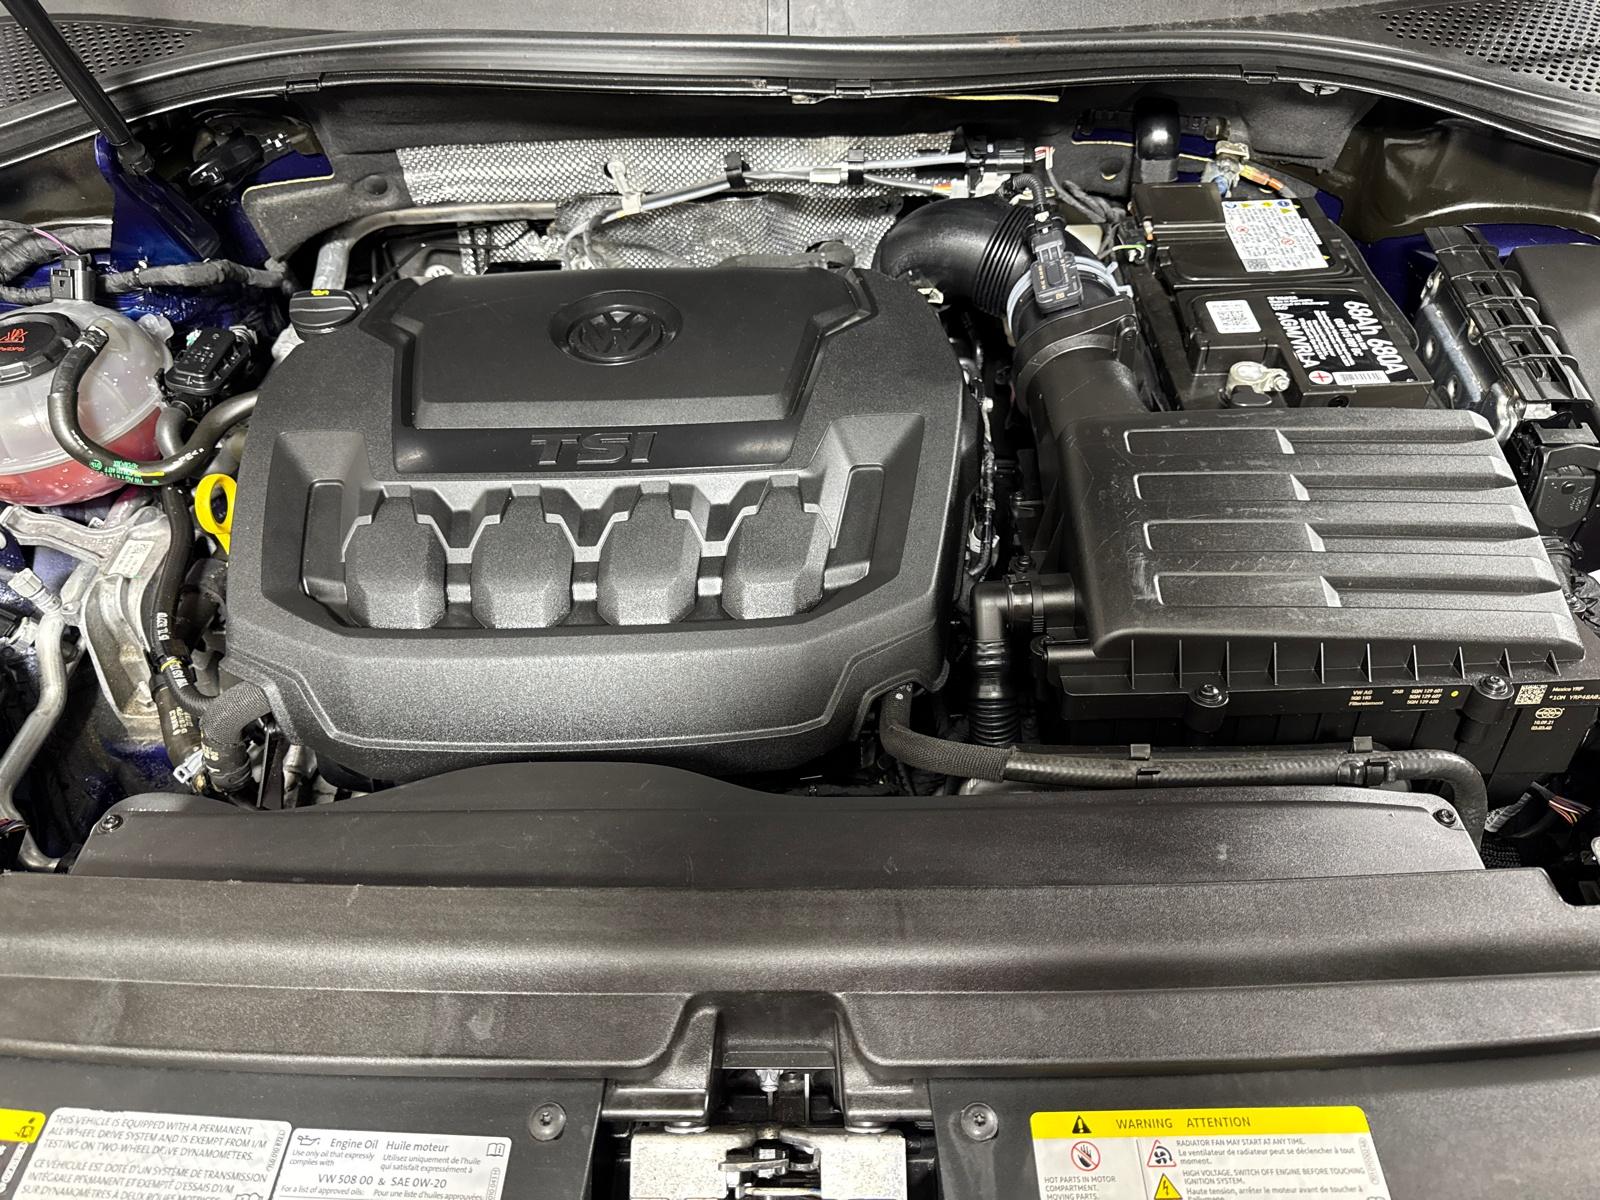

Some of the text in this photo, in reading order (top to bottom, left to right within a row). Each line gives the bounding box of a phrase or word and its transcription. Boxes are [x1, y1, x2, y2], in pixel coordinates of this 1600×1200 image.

[1274, 311, 1321, 368] AGM/VRLA
[1343, 301, 1409, 374] 68Ah 680A
[530, 431, 658, 465] TSI
[55, 1114, 75, 1124] THIS
[75, 1116, 110, 1126] VEHICLE
[121, 1120, 165, 1131] EQUIPPED
[166, 1122, 190, 1131] WITH
[198, 1123, 253, 1135] PERMANENT
[1116, 1116, 1251, 1129] WARNING ATTENTION
[48, 1127, 96, 1137] ALL-WHEEL
[97, 1130, 124, 1139] DRIVE
[158, 1133, 178, 1143] AND
[182, 1135, 188, 1143] IS
[189, 1136, 224, 1146] EXEMPT
[224, 1138, 250, 1147] FROM
[1272, 1137, 1286, 1145] ANY
[44, 1139, 254, 1160] TESTING ON TWO-WHEEL DRIVE DYNAMOMETERS.
[330, 1138, 379, 1150] Engine Oil
[386, 1141, 449, 1152] Huile moteur
[344, 1152, 375, 1160] expressly
[1188, 1148, 1226, 1156] ventilateur
[1227, 1148, 1236, 1156] de
[1237, 1147, 1268, 1155] radiateur
[1270, 1148, 1286, 1156] peut
[289, 1159, 318, 1167] complies
[409, 1156, 452, 1164] uniquement
[451, 1156, 459, 1164] de
[460, 1157, 481, 1165] l'huile
[33, 1159, 46, 1168] CE
[88, 1162, 104, 1172] EST
[190, 1168, 203, 1178] DE
[204, 1169, 268, 1183] TRANSMISSION
[393, 1163, 419, 1171] satisfait
[420, 1166, 465, 1174] expressément
[1234, 1168, 1260, 1176] SWITCH
[1260, 1168, 1274, 1176] OFF
[1276, 1168, 1301, 1176] ENGINE
[1330, 1167, 1365, 1175] TOUCHING
[73, 1174, 125, 1186] PERMANENT
[318, 1174, 447, 1188] VW 508 00 & SAE 0W-20
[281, 1184, 292, 1192] For
[299, 1185, 309, 1193] list
[319, 1187, 351, 1196] approved
[1045, 1184, 1099, 1192] COMPARTMENT.
[1209, 1187, 1237, 1195] tension,
[1239, 1186, 1262, 1194] arrêter
[1263, 1186, 1270, 1194] le
[1330, 1185, 1357, 1193] toucher
[404, 1190, 417, 1198] liste
[418, 1191, 444, 1199] d'huiles
